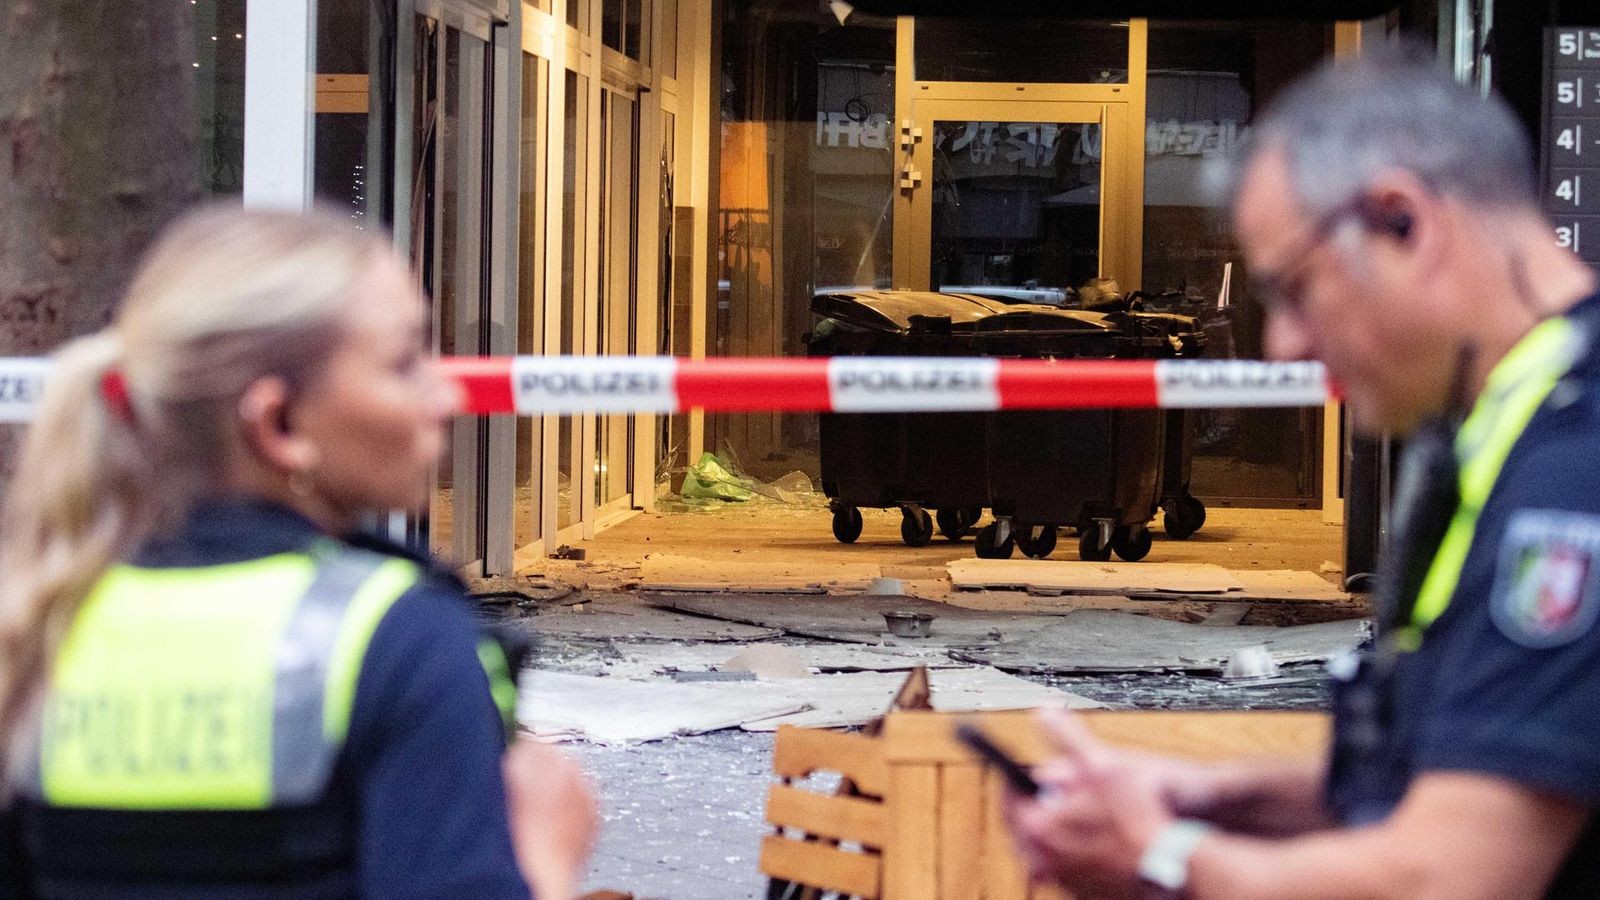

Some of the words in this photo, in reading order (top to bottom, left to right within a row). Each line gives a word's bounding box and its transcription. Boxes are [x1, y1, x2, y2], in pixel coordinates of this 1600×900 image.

[1559, 33, 1576, 55] 5
[1557, 82, 1575, 104] 5
[1556, 128, 1574, 150] 4
[1555, 179, 1573, 201] 4
[1555, 226, 1572, 248] 3
[519, 371, 660, 397] POLIZEI
[837, 367, 984, 394] POLIZEI
[48, 690, 262, 774] POLIZEI
